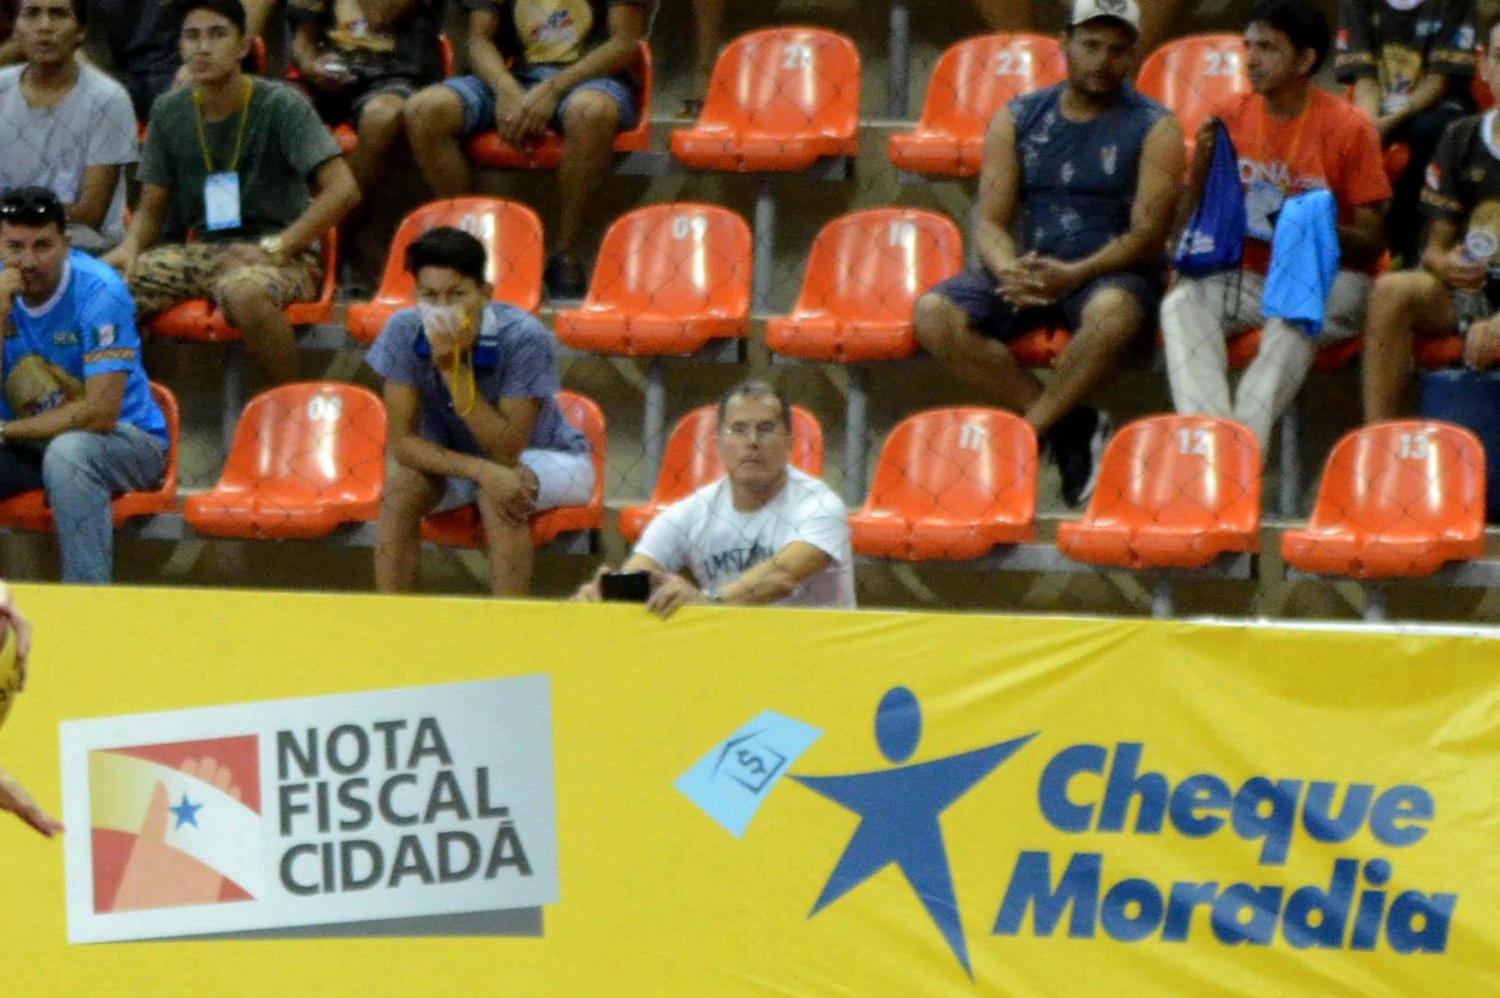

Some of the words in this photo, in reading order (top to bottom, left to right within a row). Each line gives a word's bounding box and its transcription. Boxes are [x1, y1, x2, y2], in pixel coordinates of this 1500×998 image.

[997, 52, 1029, 75] 22
[276, 716, 454, 781] NOTA
[278, 766, 510, 837] FISCAL
[1037, 741, 1436, 867] Cheque
[279, 820, 534, 896] CIDADÃ
[990, 849, 1460, 955] Moradia
